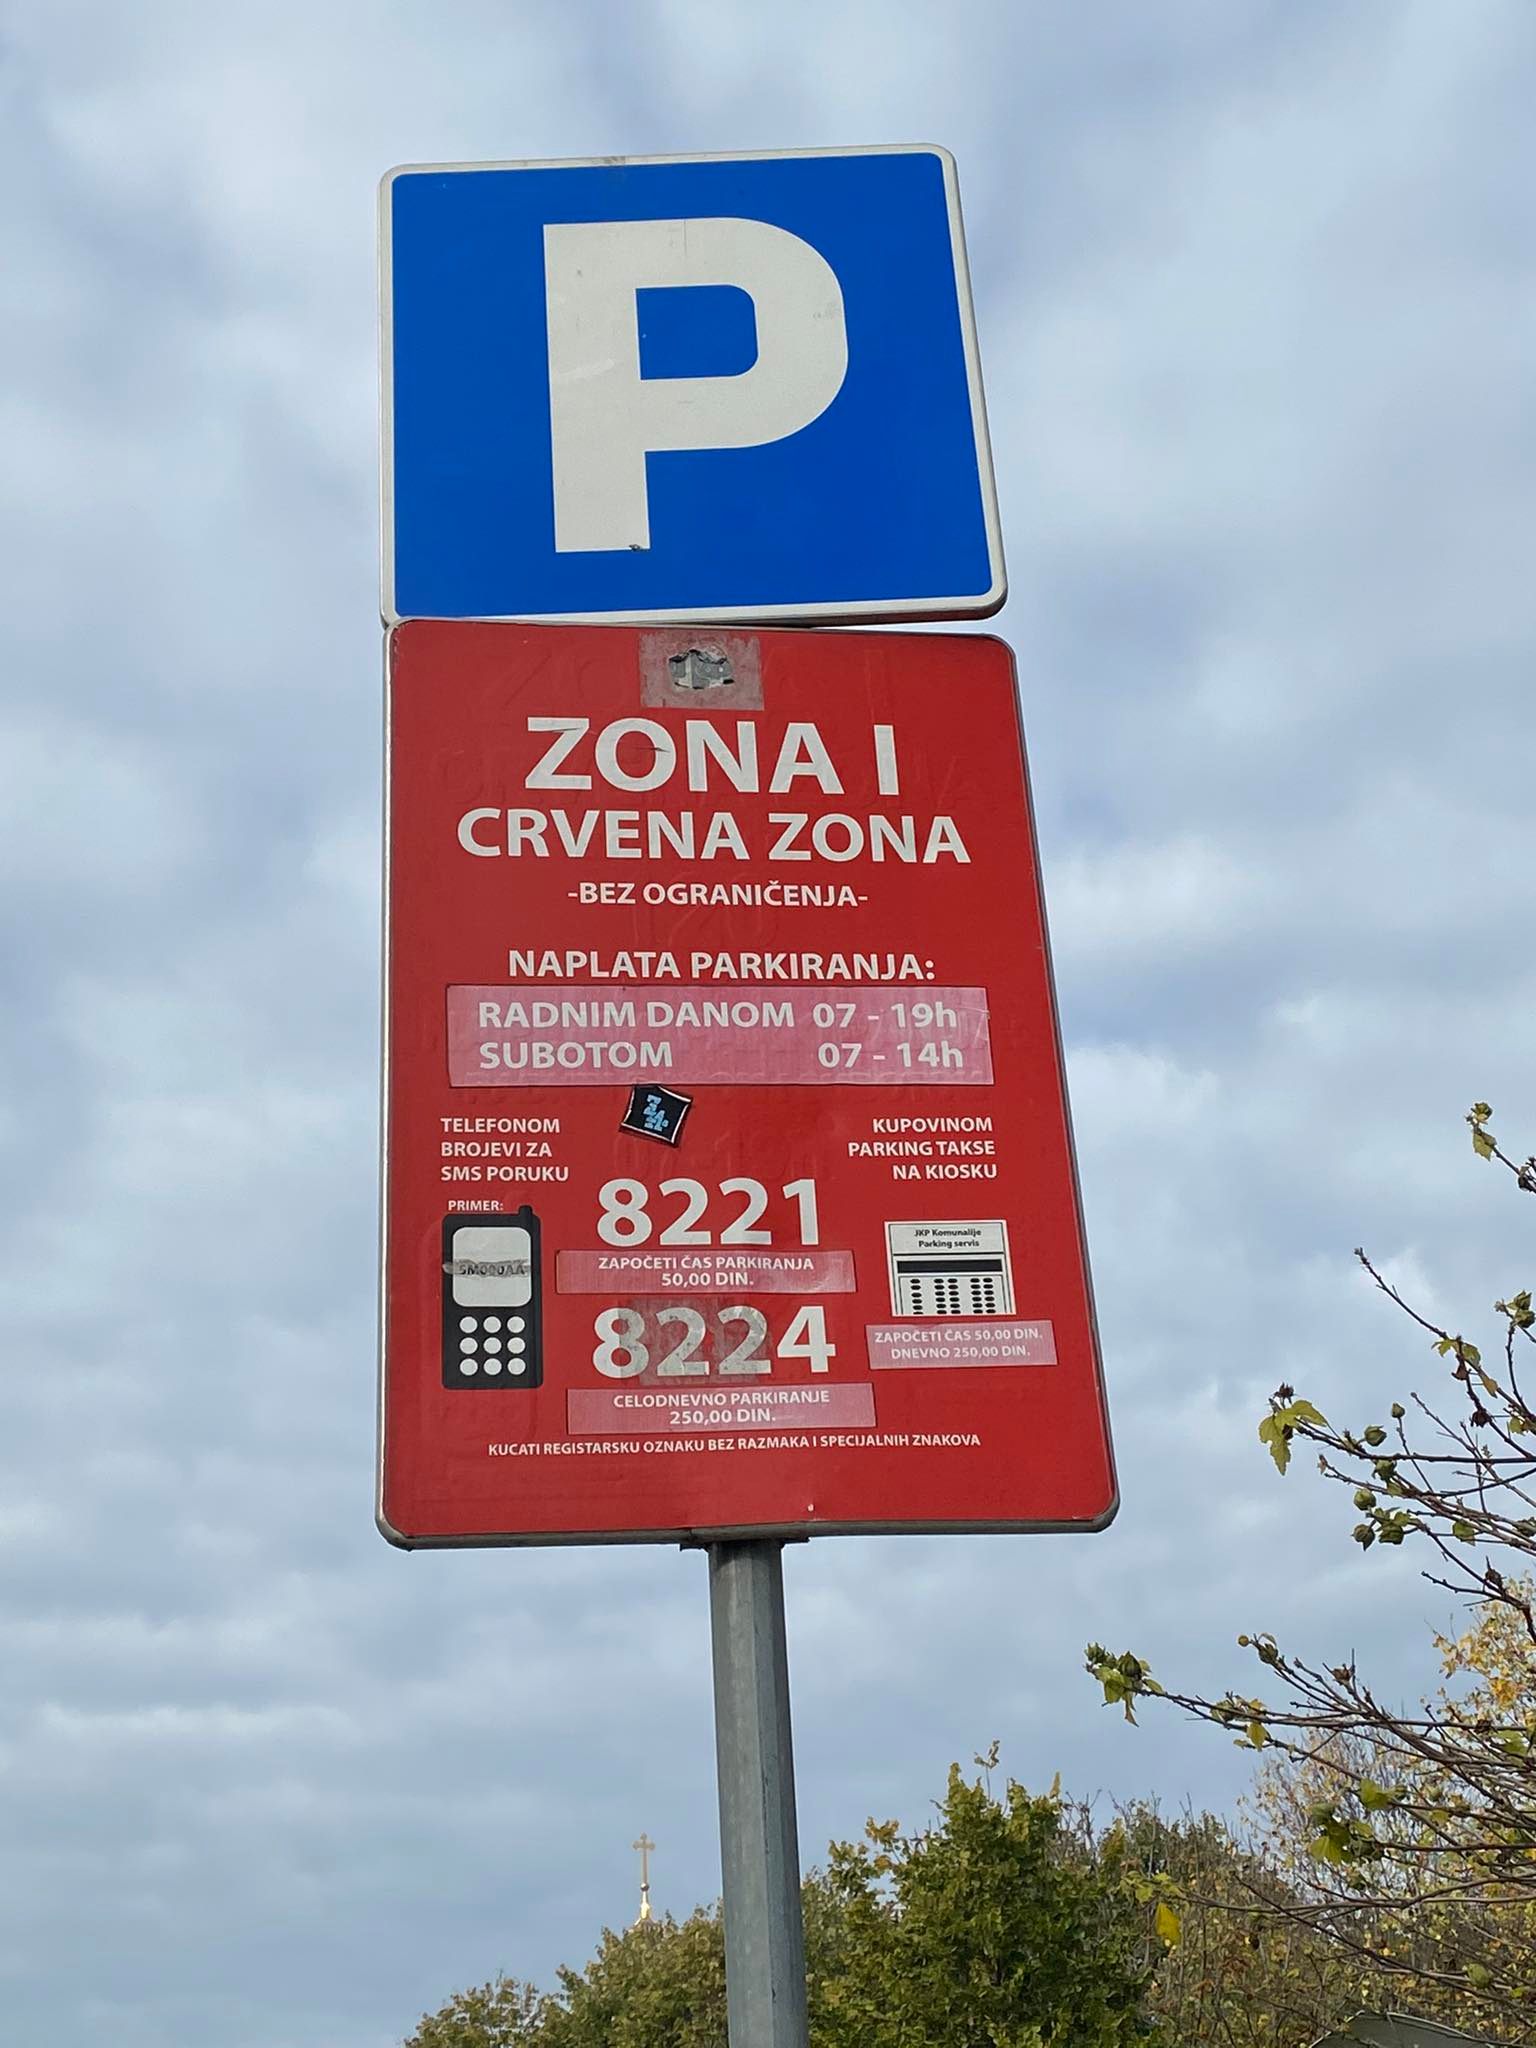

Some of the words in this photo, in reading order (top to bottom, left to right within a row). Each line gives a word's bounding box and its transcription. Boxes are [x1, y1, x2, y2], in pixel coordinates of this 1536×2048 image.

[542, 217, 849, 553] P
[524, 716, 845, 795] ZONA
[873, 724, 900, 796] I
[457, 807, 751, 860] CRVENA
[768, 812, 972, 864] ZONA
[567, 882, 636, 904] -BEZ
[642, 880, 868, 907] OGRANIČENJA-
[509, 949, 681, 978] NAPLATA
[690, 951, 935, 981] PARKIRANJA:
[479, 1001, 636, 1028] RADNIM
[646, 1001, 795, 1028] DANOM
[812, 1002, 857, 1028] 07
[890, 1001, 957, 1028] 19h
[479, 1041, 673, 1069] SUBOTOM
[818, 1042, 862, 1068] 07
[897, 1039, 964, 1068] 14h
[440, 1117, 560, 1133] TELEFONOM
[872, 1117, 993, 1133] KUPOVINOM
[441, 1141, 521, 1157] BROJEVI
[525, 1142, 553, 1157] ZA
[848, 1141, 933, 1157] PARKING
[935, 1140, 996, 1156] TAKSE
[441, 1165, 482, 1181] SMS
[486, 1166, 569, 1182] PORUKU
[892, 1164, 922, 1180] NA
[925, 1163, 997, 1180] KIOSKU
[448, 1200, 504, 1211] PRIMER:
[597, 1177, 819, 1247] 8221
[918, 1239, 952, 1249] Parking
[953, 1239, 980, 1247] servis
[598, 1255, 677, 1270] ZAPOČETI
[680, 1254, 713, 1269] ČAS
[715, 1256, 814, 1270] PARKIRANJA
[661, 1272, 711, 1288] 50,00
[715, 1271, 754, 1286] DIN.
[592, 1305, 836, 1379] 8224
[874, 1330, 942, 1344] ZAPOČETI
[944, 1328, 972, 1342] ČAS
[974, 1329, 1011, 1342] 50,00
[1013, 1327, 1043, 1340] DIN.
[891, 1347, 951, 1360] DNEVNO
[953, 1346, 999, 1359] 250,00
[1001, 1344, 1031, 1357] DIN.
[613, 1392, 727, 1408] CELODNEVNO
[730, 1390, 830, 1405] PARKIRANJE
[669, 1409, 733, 1426] 250,00
[736, 1407, 777, 1423] DIN.
[488, 1443, 540, 1456] KUCATI
[543, 1441, 640, 1455] REGISTARSKU
[643, 1439, 705, 1453] OZNAKU
[708, 1438, 735, 1451] BEZ
[737, 1435, 810, 1450] RAZMAKA
[812, 1435, 817, 1447] I
[820, 1434, 909, 1447] SPECIJALNIH
[912, 1434, 981, 1446] ZNAKOVA
